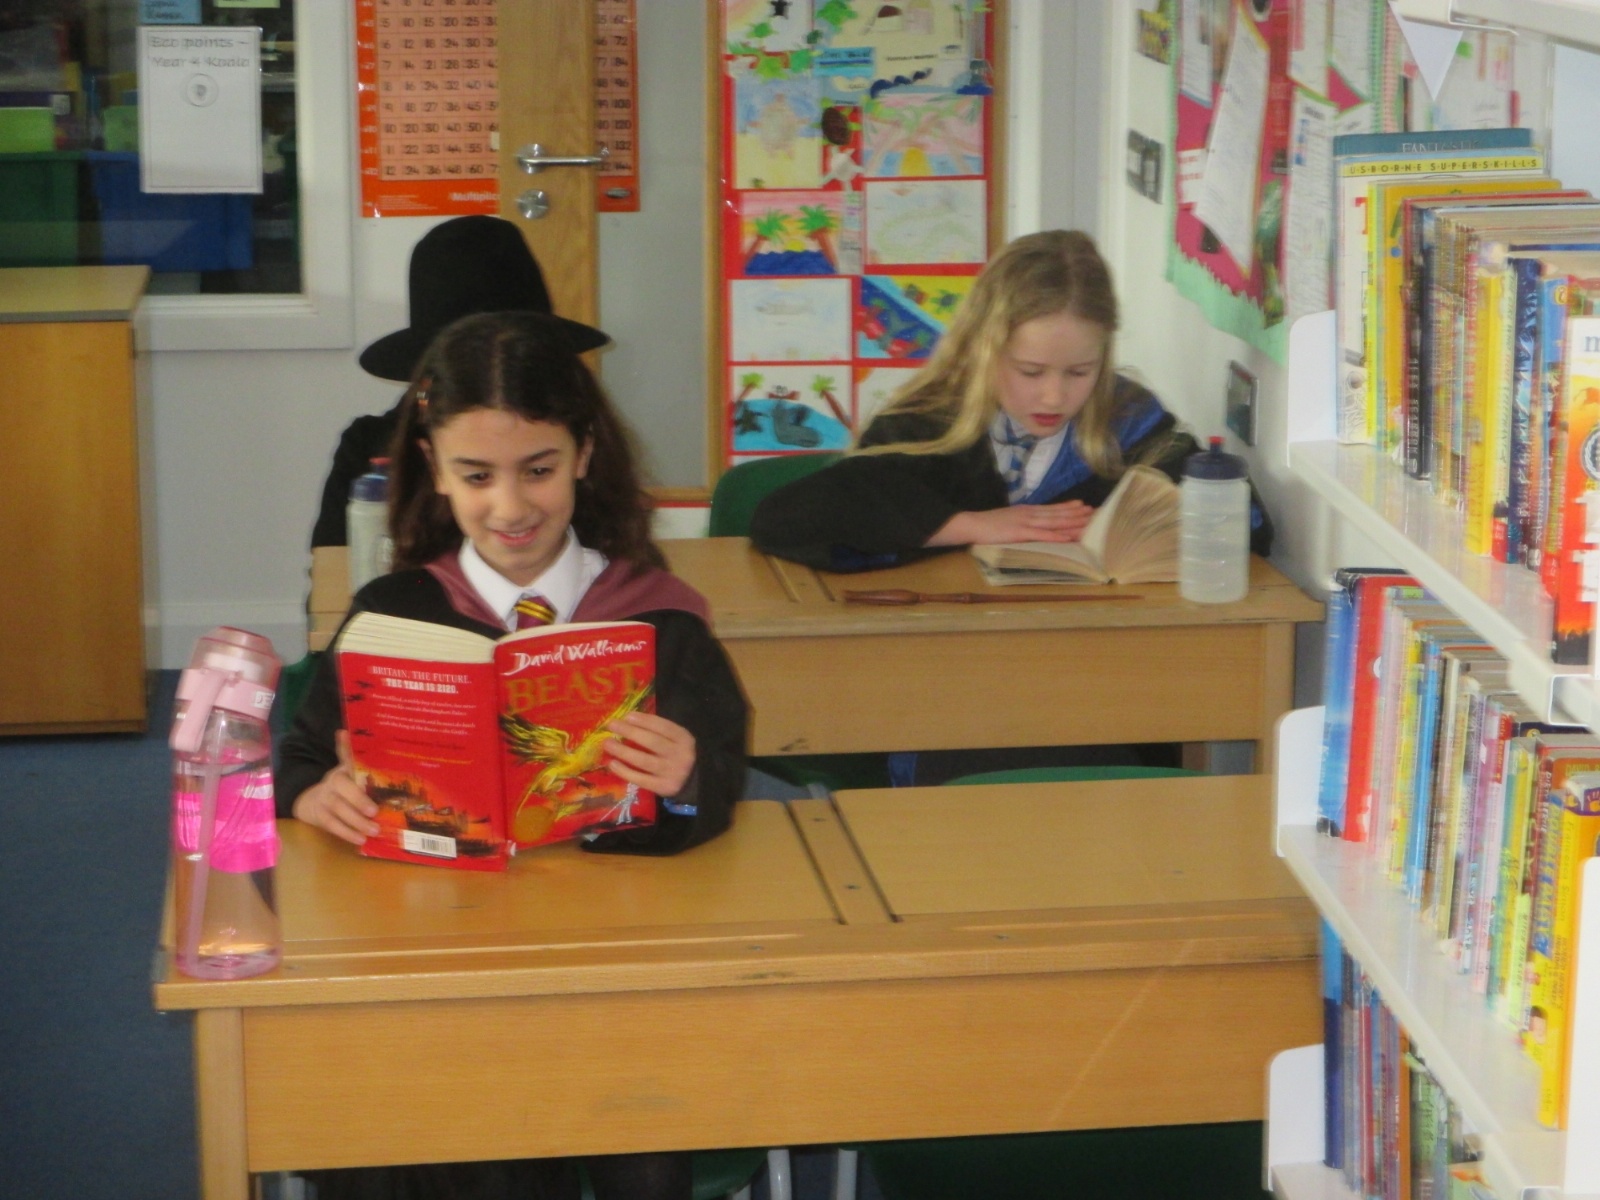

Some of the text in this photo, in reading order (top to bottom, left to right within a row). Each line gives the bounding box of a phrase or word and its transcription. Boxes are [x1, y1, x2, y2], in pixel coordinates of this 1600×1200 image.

[500, 640, 647, 676] David Walliams
[404, 680, 425, 691] YEAR
[412, 671, 431, 681] THE
[505, 660, 647, 713] BEAST
